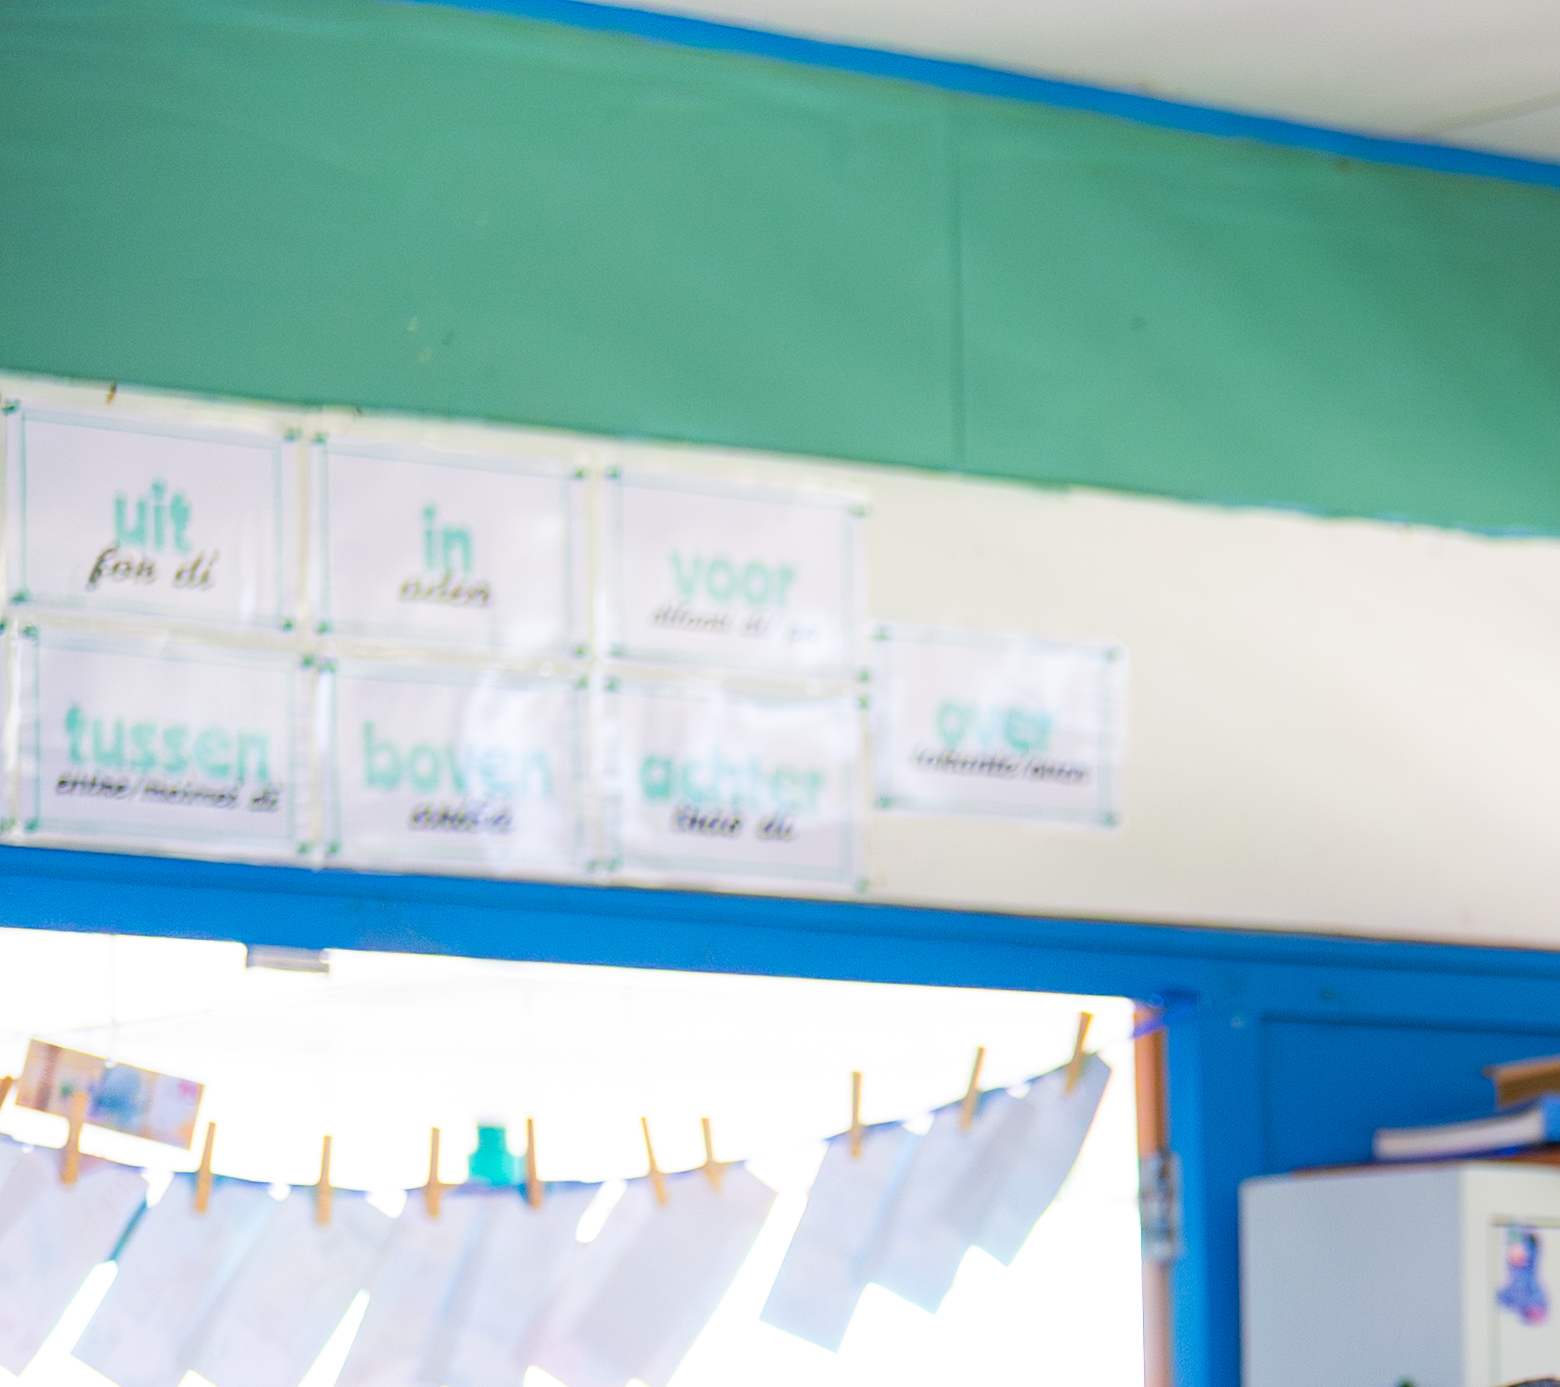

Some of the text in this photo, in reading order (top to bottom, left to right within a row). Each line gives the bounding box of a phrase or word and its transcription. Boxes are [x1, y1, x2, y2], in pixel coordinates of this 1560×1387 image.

[114, 478, 192, 552] uit
[422, 502, 475, 574] in
[669, 550, 798, 608] voor
[65, 702, 269, 784] tussen
[362, 716, 553, 800] boven
